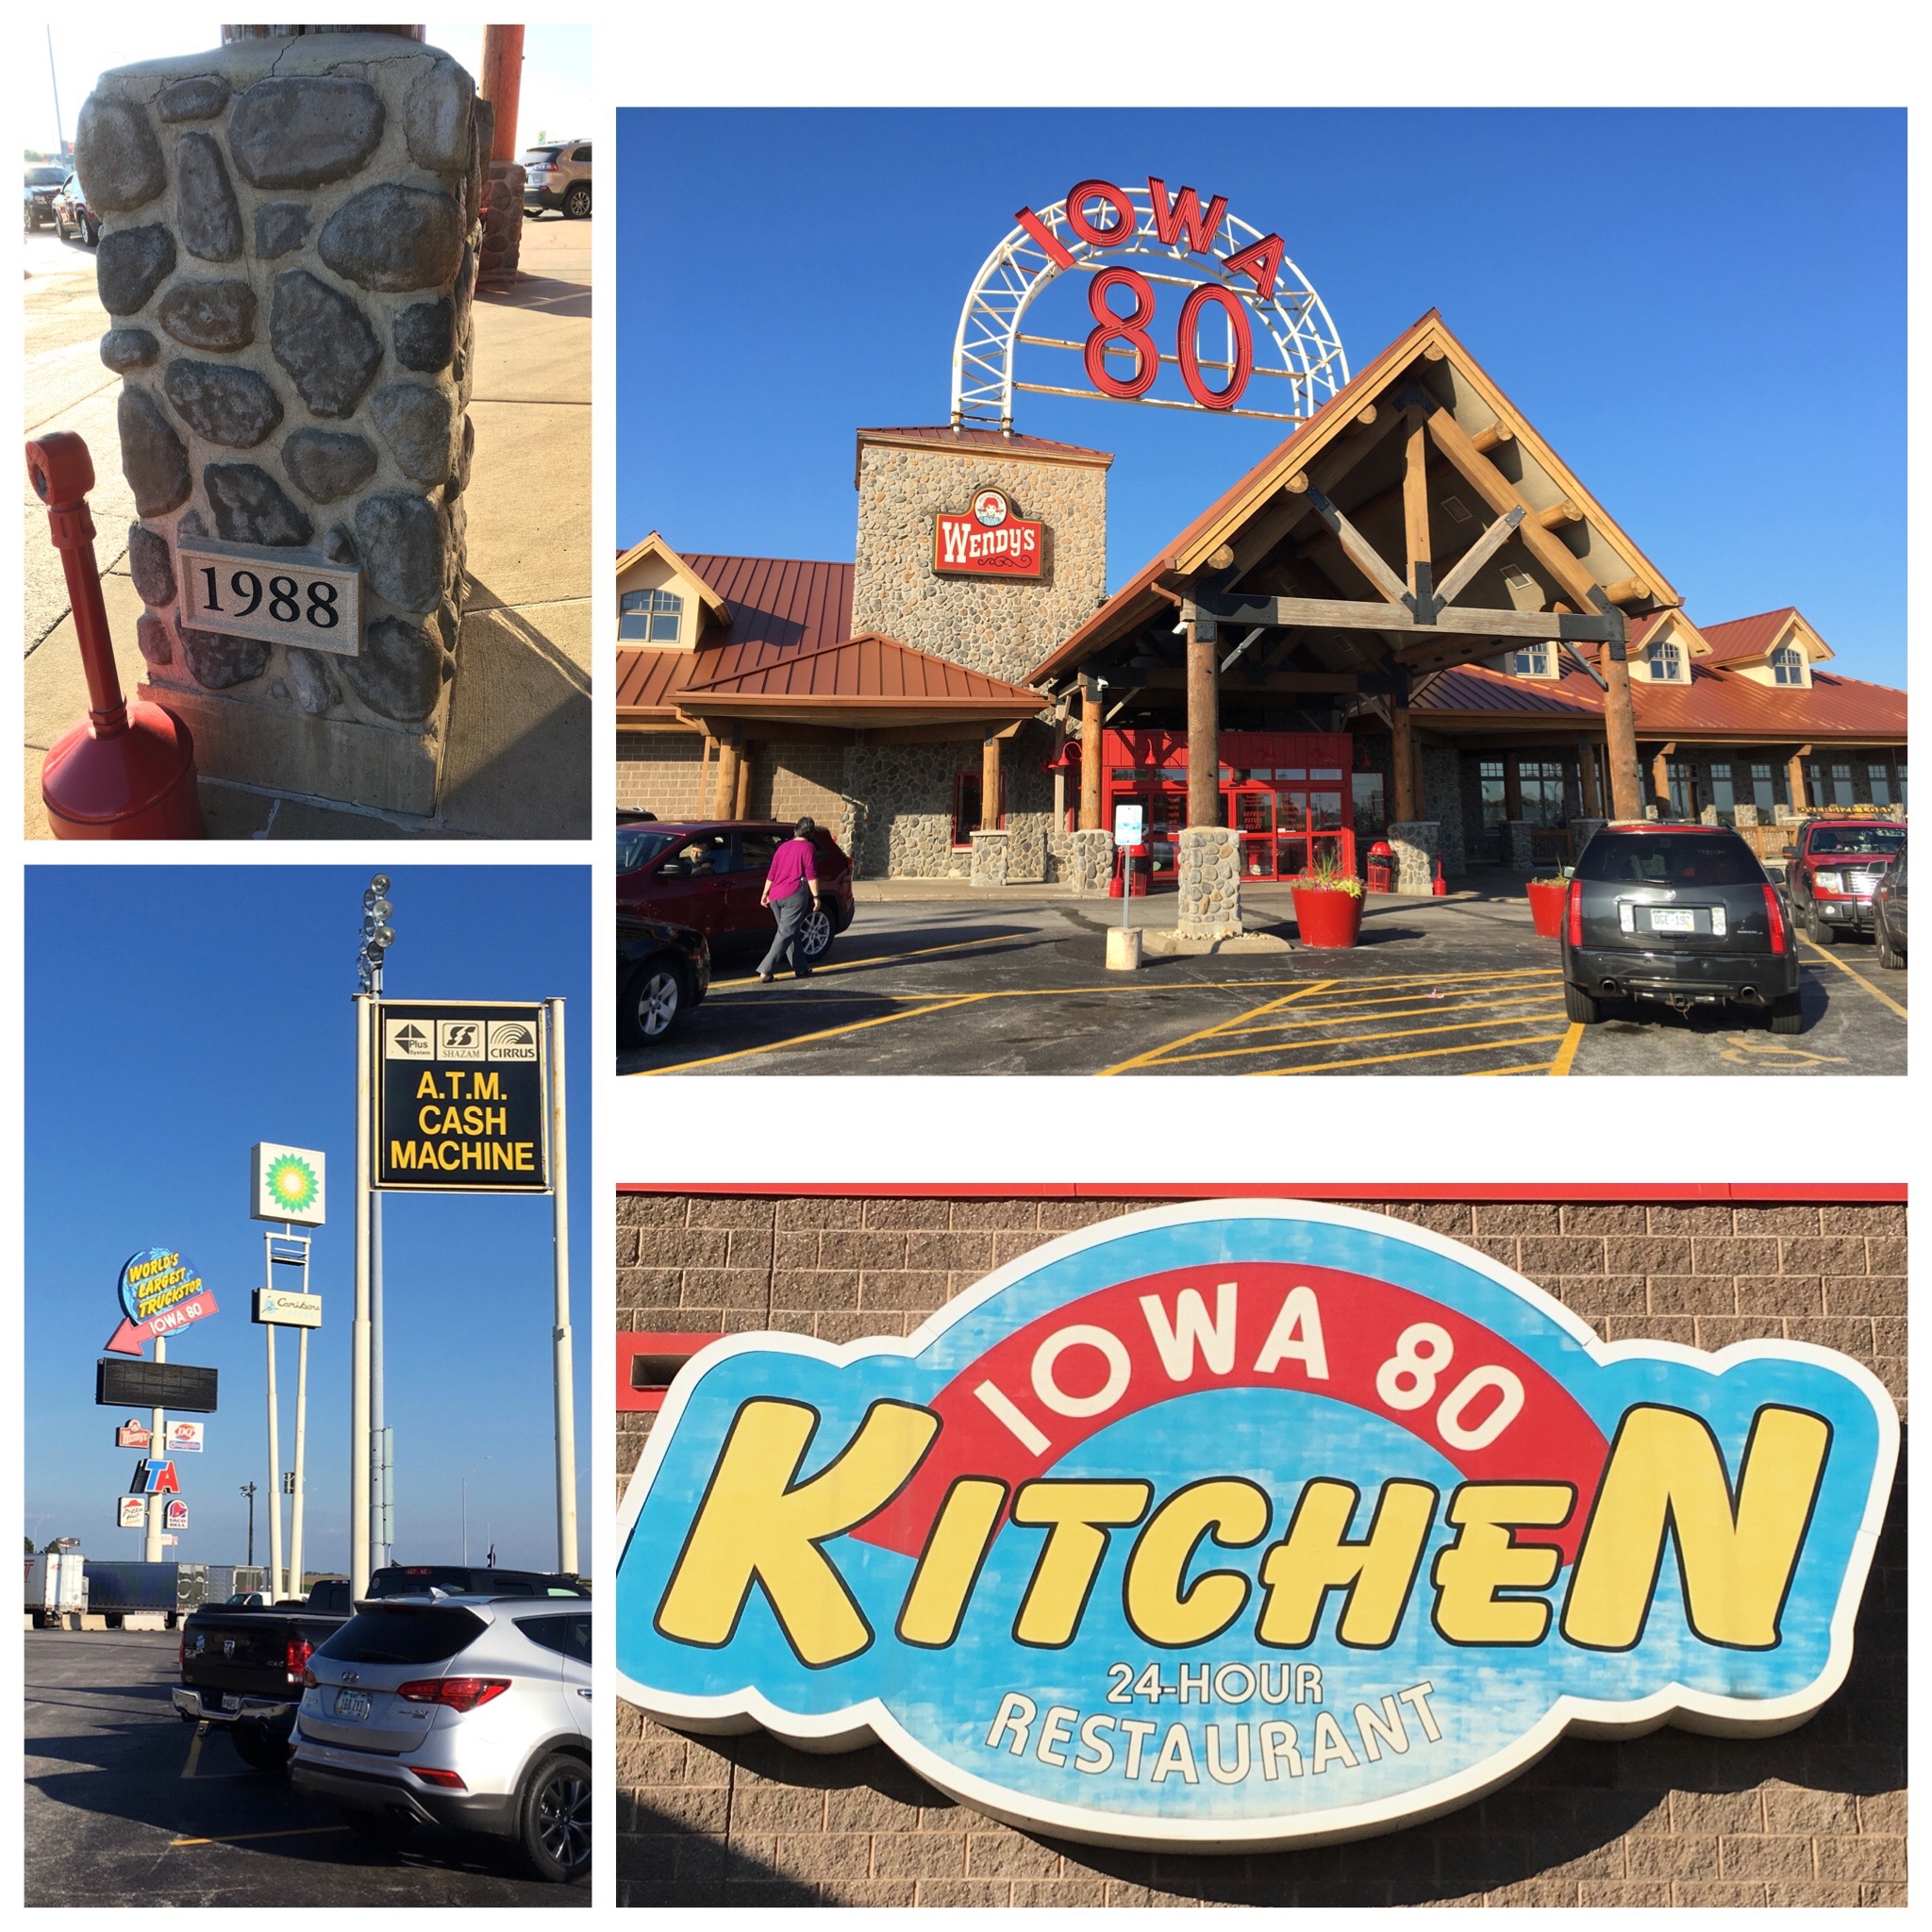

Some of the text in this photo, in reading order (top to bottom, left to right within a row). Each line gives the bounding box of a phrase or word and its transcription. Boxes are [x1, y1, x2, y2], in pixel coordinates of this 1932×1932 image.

[1014, 175, 1285, 301] IOWA
[1084, 266, 1254, 409] 80
[200, 566, 340, 628] 1988
[409, 1040, 428, 1050] Plus
[442, 1049, 480, 1058] SHAZAM
[491, 1048, 535, 1058] CIRRUS
[416, 1071, 508, 1100] A.T.M.
[418, 1106, 508, 1136] CASH
[390, 1141, 535, 1171] MACHINE
[127, 1253, 179, 1284] WORLD'S
[137, 1267, 186, 1299] LARGEST
[138, 1277, 202, 1319] TRUCKSTOP
[276, 1297, 320, 1311] Caribou
[149, 1303, 203, 1335] IOWA 80
[974, 1282, 1526, 1457] IOWA 80
[177, 1426, 192, 1438] DQ
[144, 1458, 181, 1493] TA
[123, 1507, 143, 1518] Pizza
[652, 1395, 1834, 1671] KITCHEN
[1106, 1661, 1324, 1706] 24-HOUR
[984, 1679, 1445, 1786] RESTAURANT
